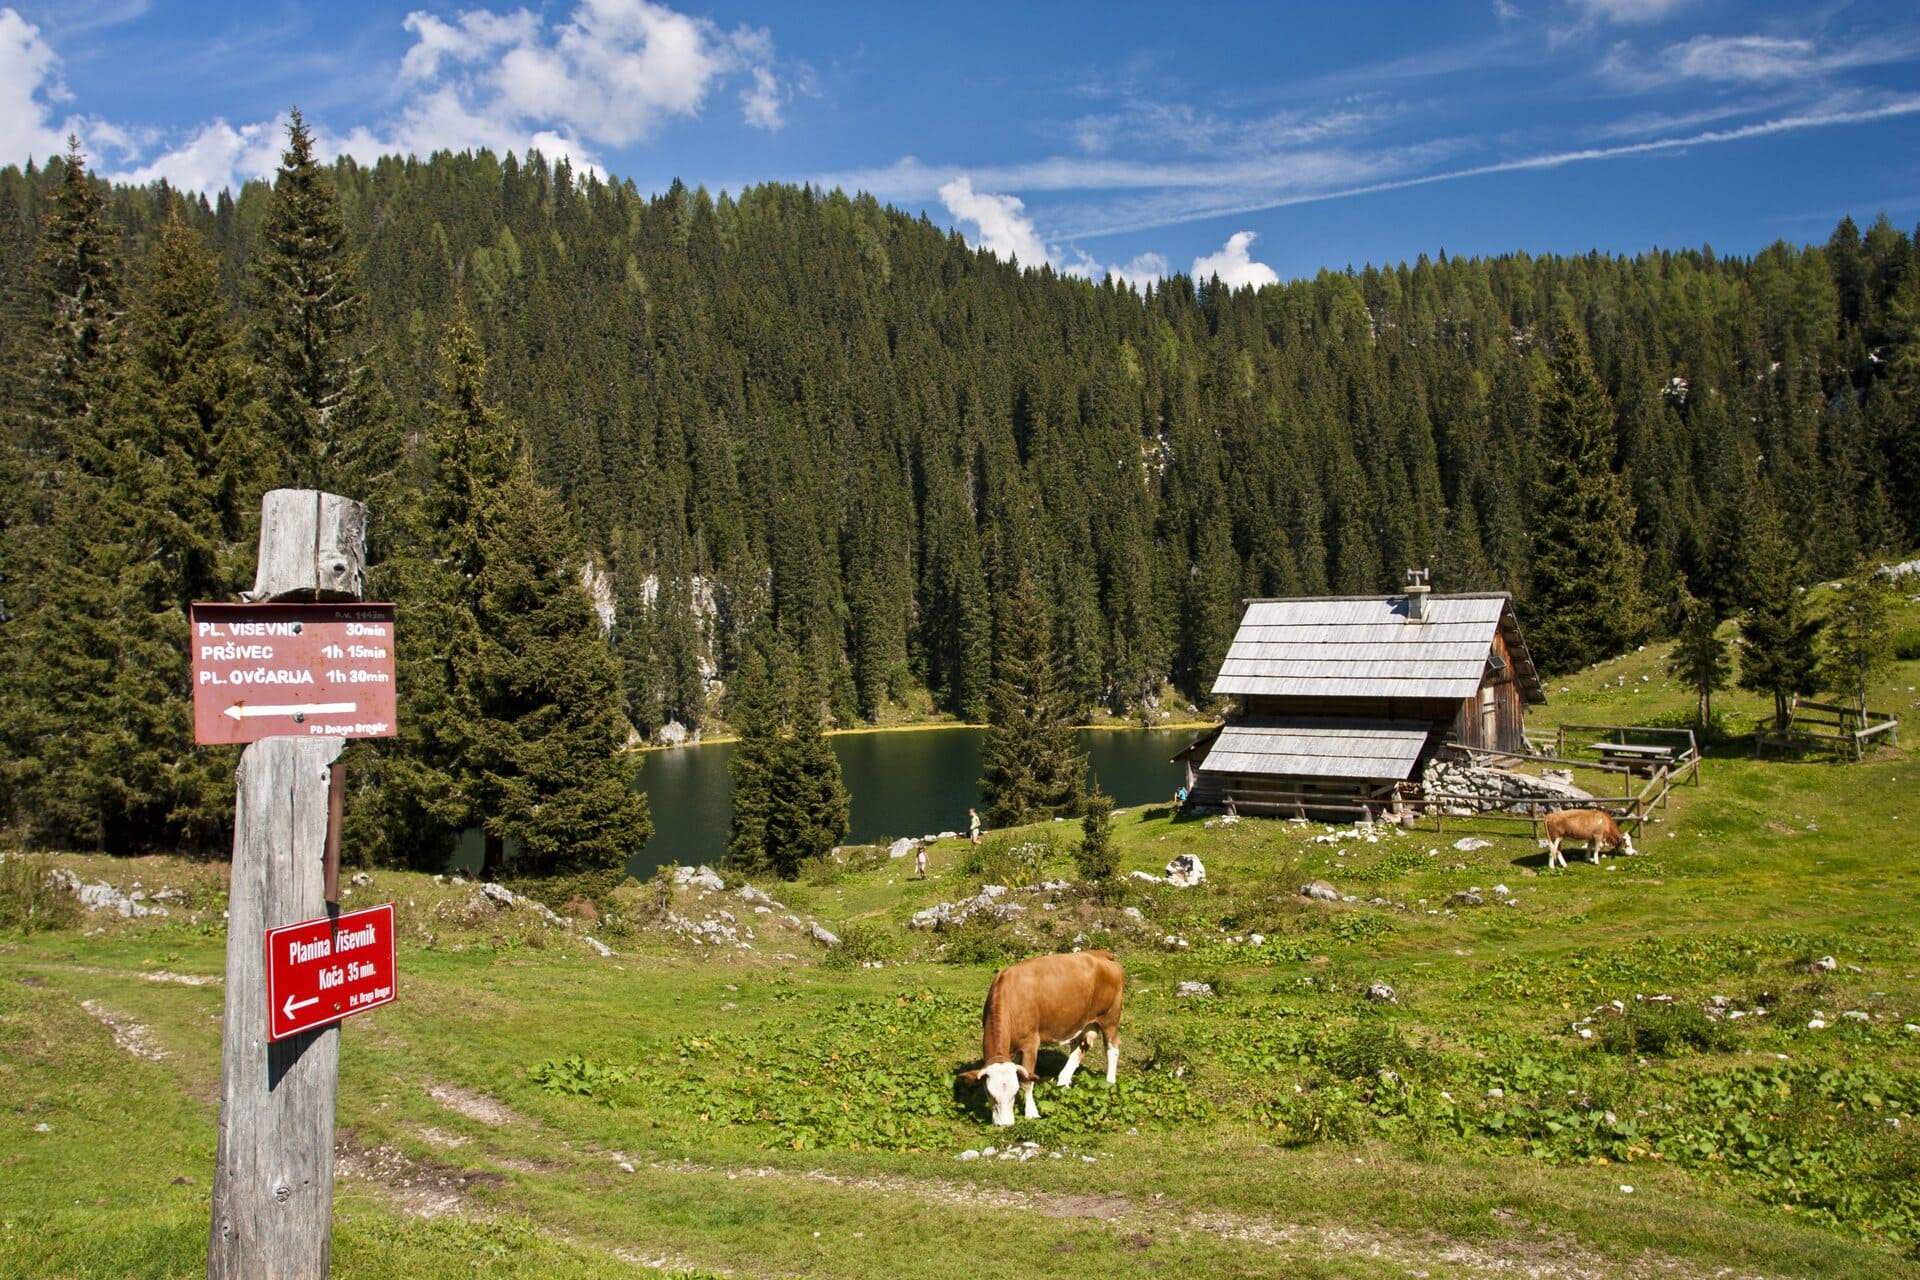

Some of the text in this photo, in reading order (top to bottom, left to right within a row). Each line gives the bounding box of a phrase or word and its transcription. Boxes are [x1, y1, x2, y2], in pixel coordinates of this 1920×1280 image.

[199, 623, 224, 637] PL.
[345, 623, 386, 637] 30min
[201, 642, 386, 660] PRŠIVEC 1h 15min
[199, 667, 389, 685] PL. OVČARIJA 1h 30min
[325, 724, 354, 736] Drago
[289, 936, 331, 966] Planina
[319, 965, 344, 990] Koča
